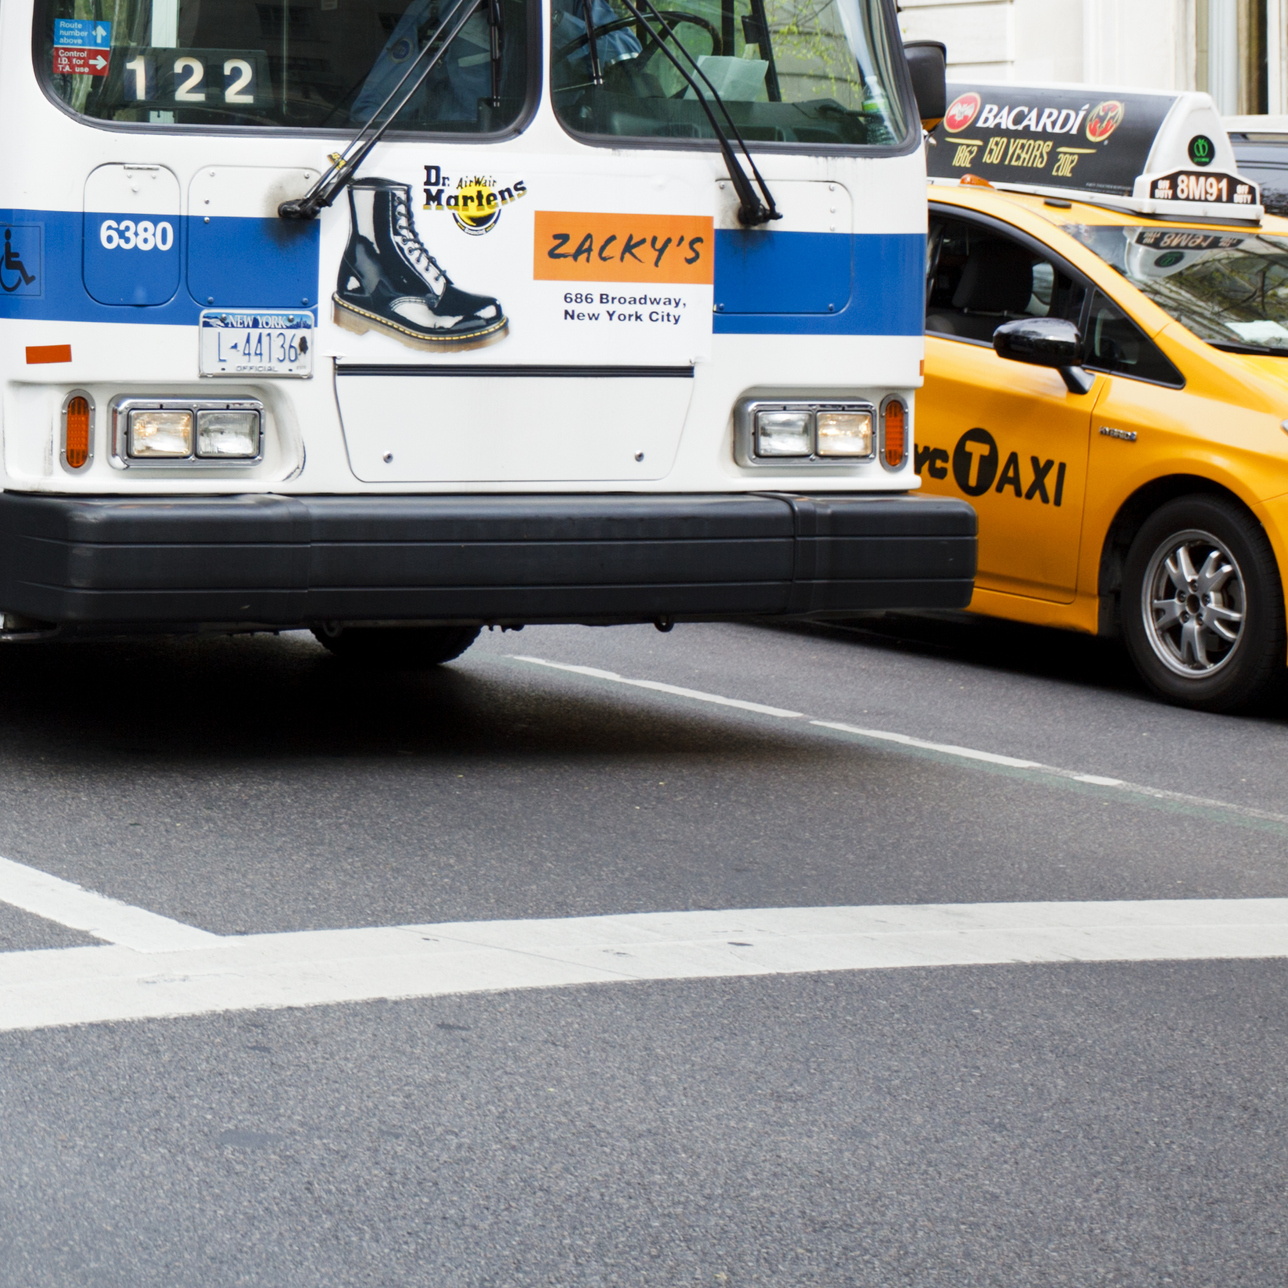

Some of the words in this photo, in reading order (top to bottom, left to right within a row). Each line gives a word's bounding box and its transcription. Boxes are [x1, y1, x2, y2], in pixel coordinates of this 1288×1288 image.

[59, 21, 83, 29] Route
[59, 29, 89, 37] number
[58, 36, 83, 44] above
[58, 49, 88, 57] Control
[72, 57, 84, 65] for
[975, 103, 1091, 135] BACARDÍ
[951, 144, 978, 169] 1862
[982, 136, 1006, 164] 150
[1004, 138, 1054, 169] YEARS
[423, 164, 450, 188] Dr.
[1051, 153, 1079, 178] 2012
[422, 179, 528, 212] Martens
[1176, 174, 1228, 203] 8M91
[99, 220, 175, 252] 6380
[547, 232, 705, 268] ZACKY'S
[563, 292, 595, 306] 686
[599, 293, 687, 309] Broadway,
[228, 314, 255, 328] NEW
[255, 315, 287, 329] YORK
[563, 309, 602, 323] New
[605, 310, 644, 323] York
[648, 310, 682, 326] City
[963, 439, 1067, 508] TAXI
